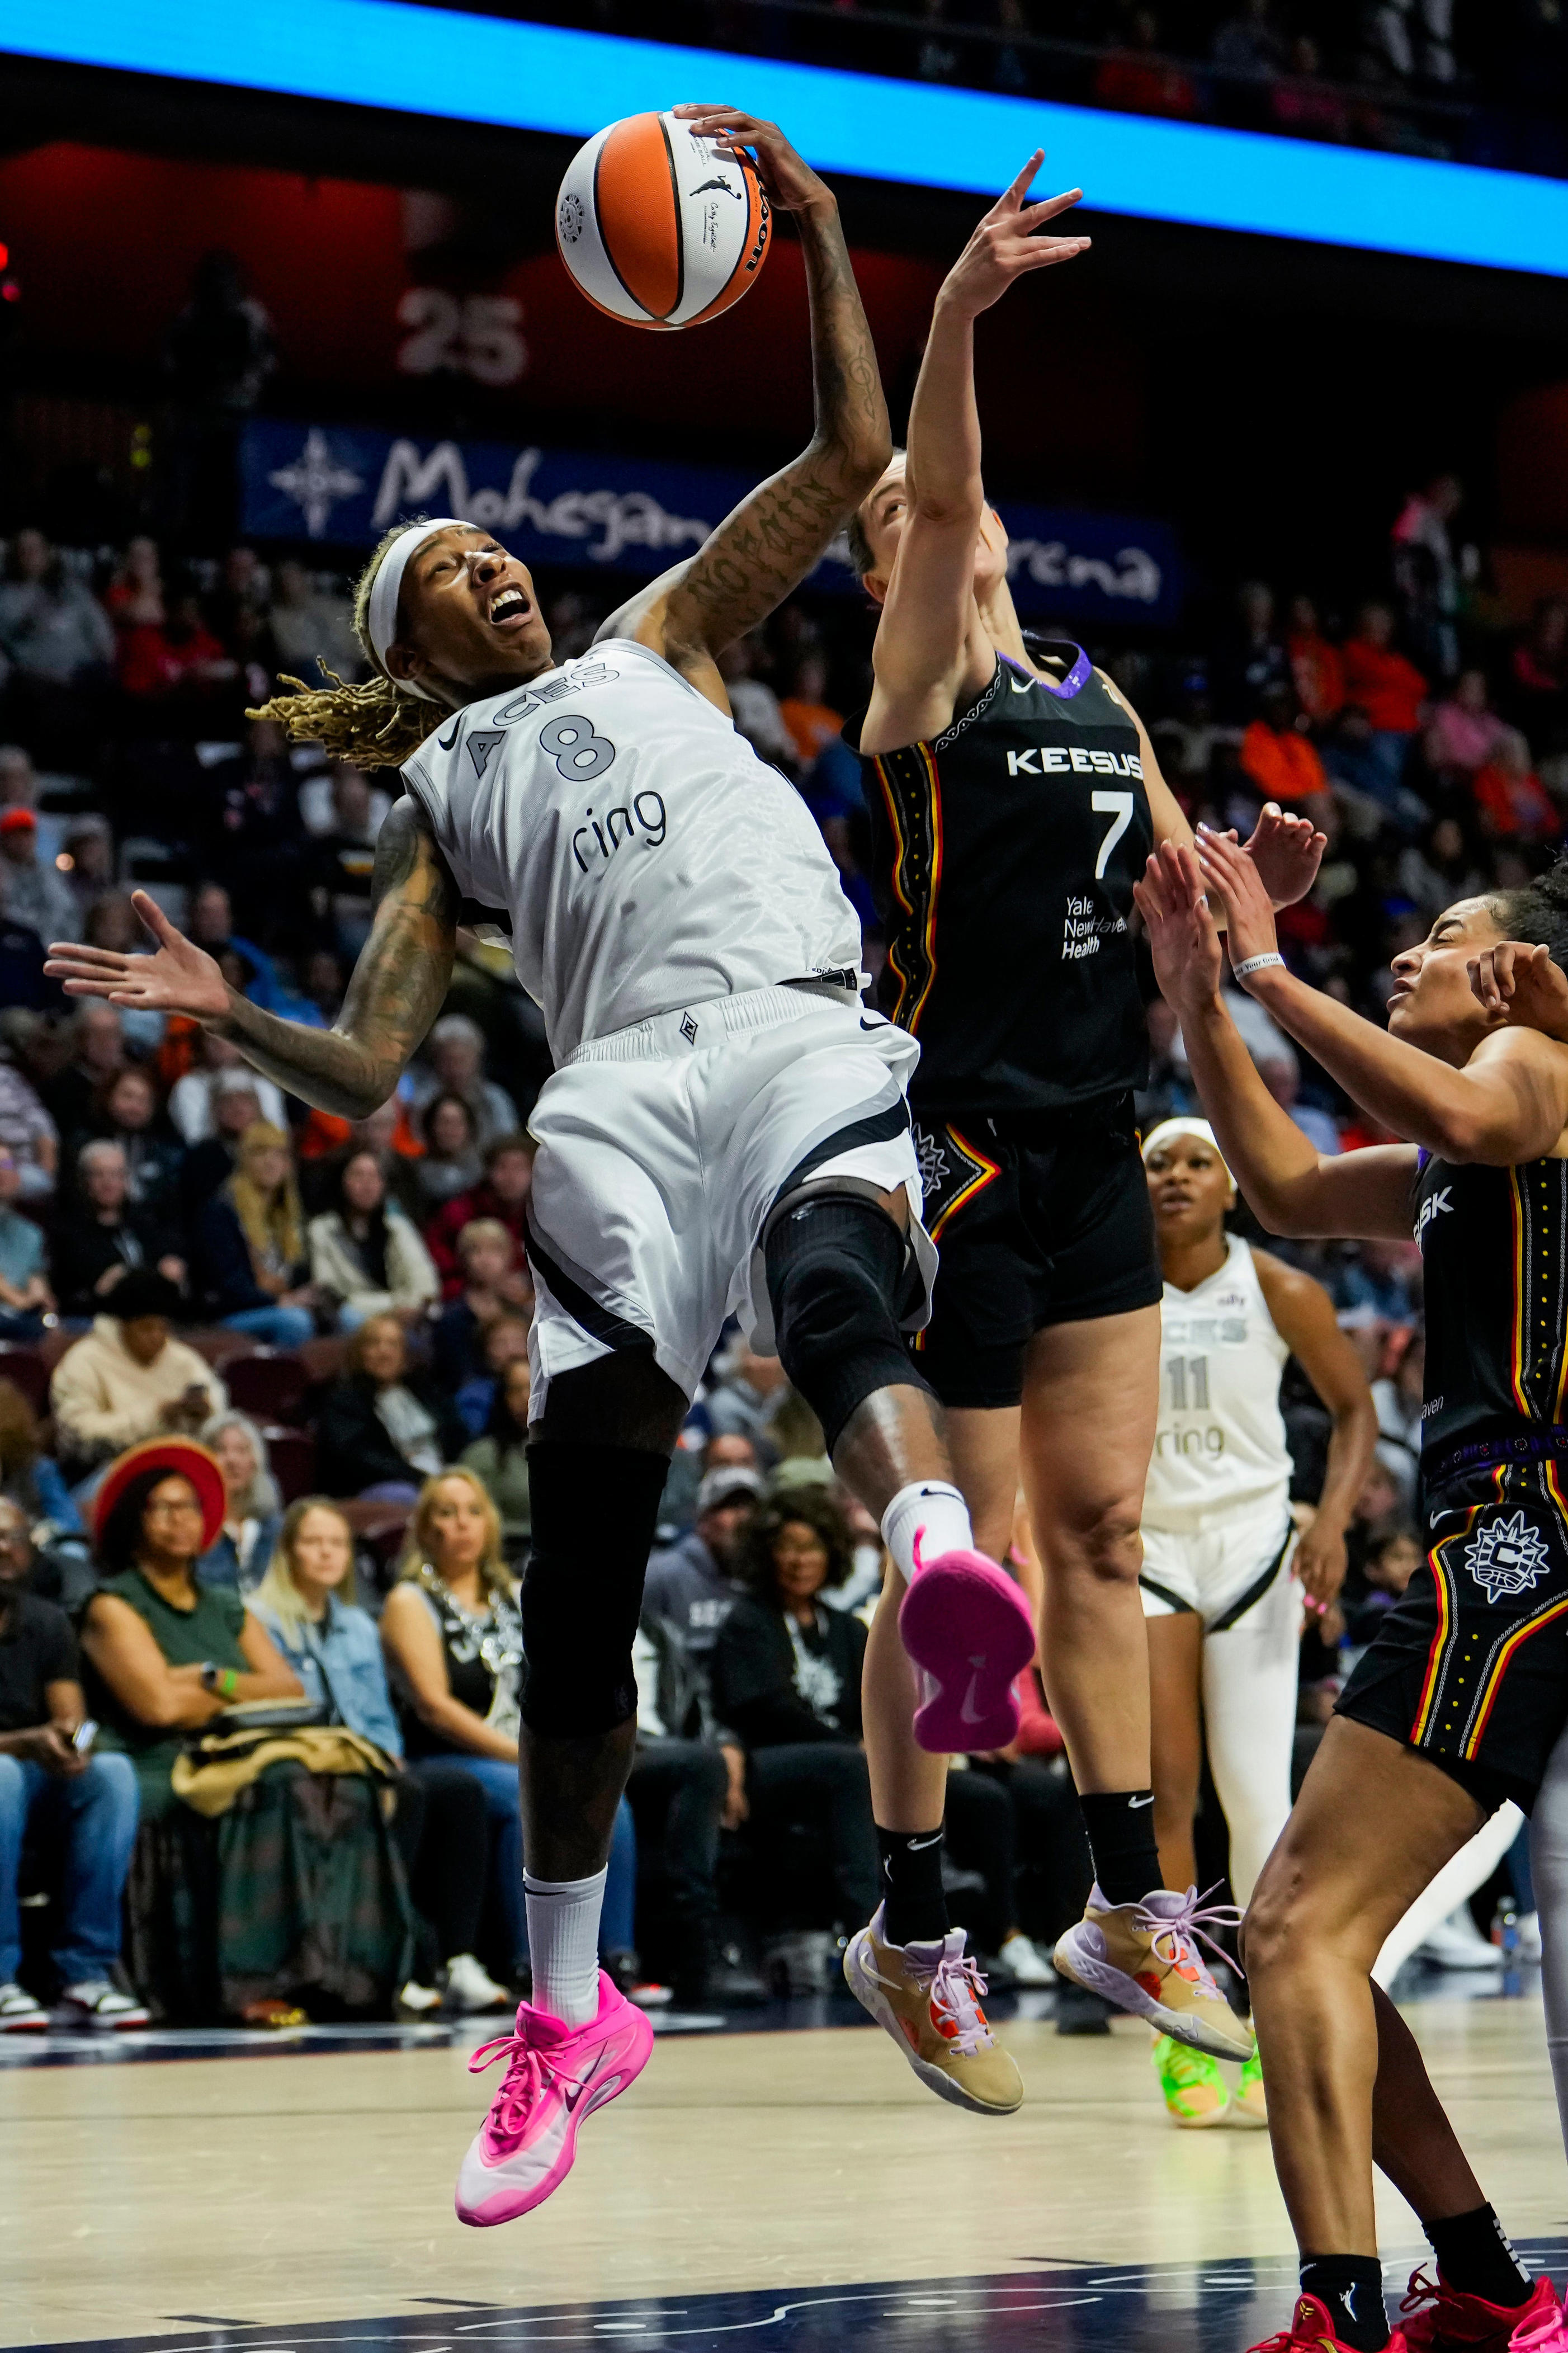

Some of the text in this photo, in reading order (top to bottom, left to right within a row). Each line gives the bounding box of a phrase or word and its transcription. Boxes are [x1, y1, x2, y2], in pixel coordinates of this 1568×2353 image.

[398, 286, 528, 386] 25
[371, 438, 1161, 604] Mohegan rena
[466, 662, 620, 779] ACES
[539, 714, 615, 781] 8
[573, 791, 666, 873] ring
[1092, 790, 1134, 879] 7
[1064, 918, 1094, 939] New
[1066, 895, 1094, 916] Yale
[1061, 935, 1100, 960] Health
[1166, 1356, 1210, 1411] 11
[1421, 1395, 1444, 1420] aven
[1156, 1421, 1225, 1463] ring
